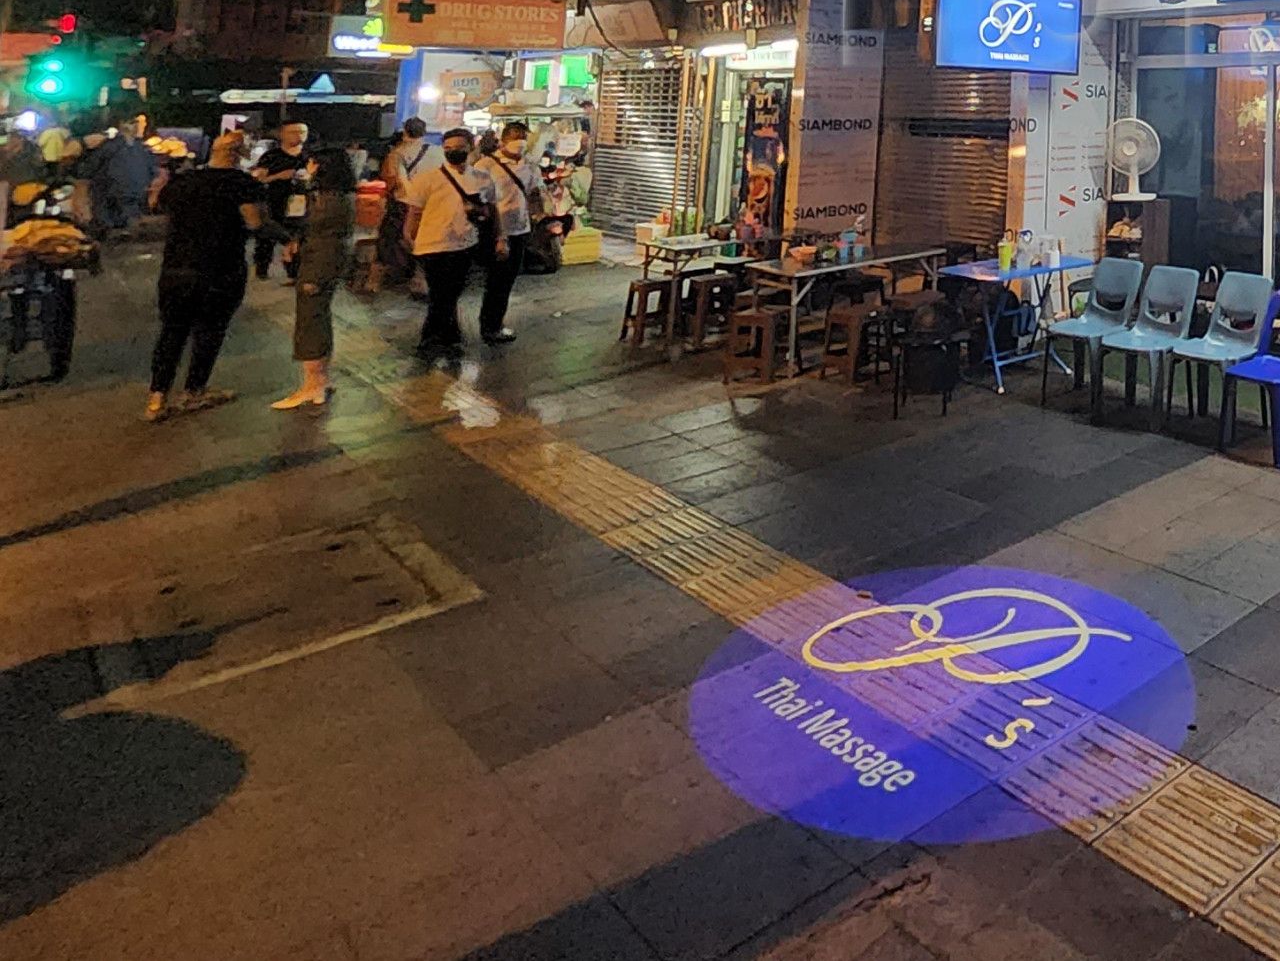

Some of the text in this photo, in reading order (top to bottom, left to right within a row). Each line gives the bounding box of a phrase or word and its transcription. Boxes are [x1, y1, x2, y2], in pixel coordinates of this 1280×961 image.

[440, 3, 560, 21] DRUG STORES
[805, 32, 877, 47] SIAMBOND
[1085, 84, 1107, 98] SIA
[798, 118, 873, 131] SIAMBOND
[1082, 187, 1105, 202] SIA
[793, 203, 868, 221] SIAMBOND
[753, 676, 917, 793] Thai Massage
